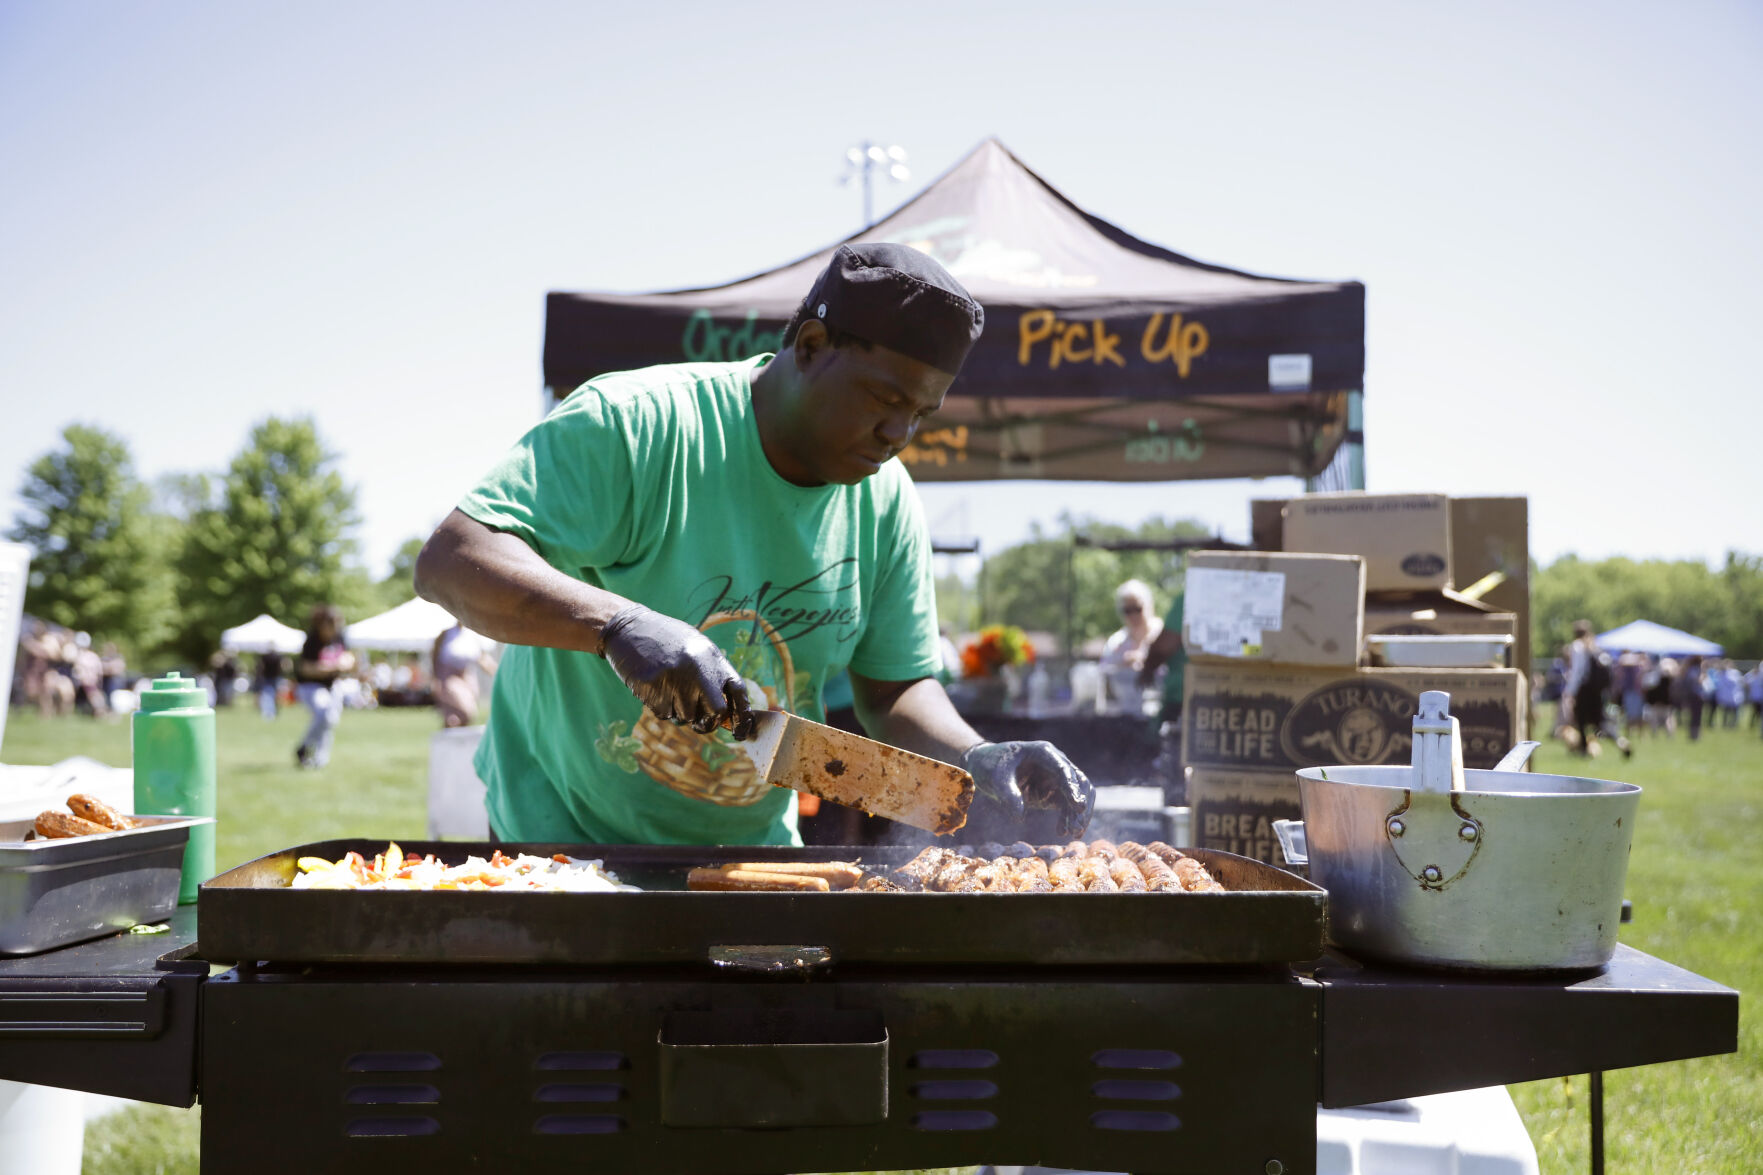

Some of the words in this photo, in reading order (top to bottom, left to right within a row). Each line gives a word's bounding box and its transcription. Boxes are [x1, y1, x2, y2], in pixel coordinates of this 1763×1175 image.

[683, 308, 786, 362] Orde
[1018, 309, 1125, 369] Pick
[1141, 312, 1209, 378] Up
[1315, 687, 1413, 717] TURANO
[1196, 707, 1276, 732] BREAD
[1219, 732, 1275, 758] LIFE
[1205, 813, 1279, 838] BREA
